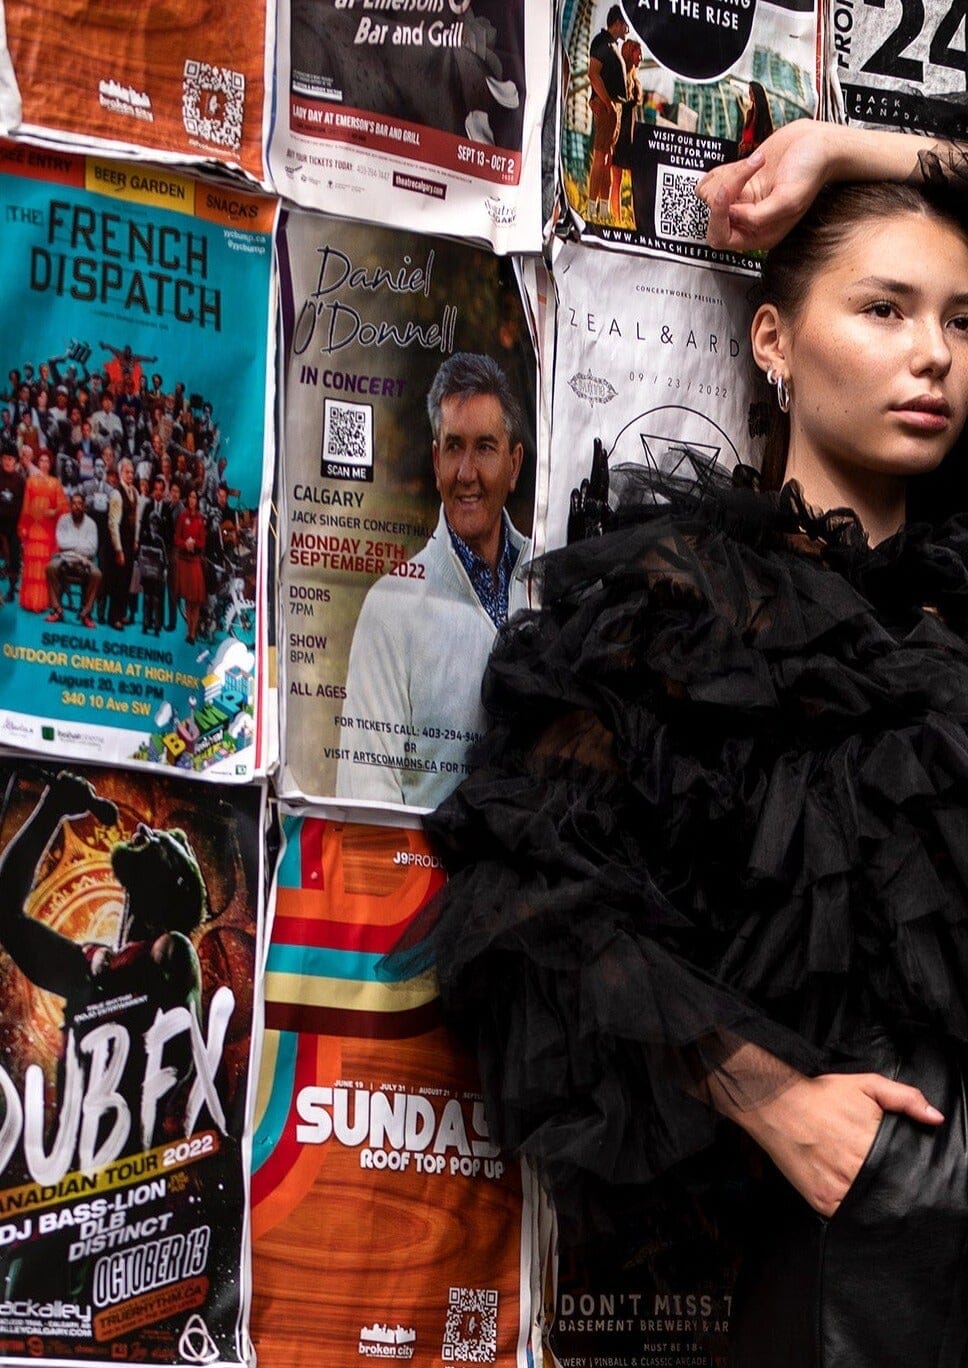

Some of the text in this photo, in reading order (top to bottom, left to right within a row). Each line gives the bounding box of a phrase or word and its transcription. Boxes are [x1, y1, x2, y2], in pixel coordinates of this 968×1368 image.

[354, 17, 464, 48] Bar and Grill
[856, 94, 901, 107] BACK
[648, 140, 725, 162] WEBSITE FOR MORE
[653, 131, 722, 151] VISIT OUR EVENT
[670, 156, 705, 168] DETAILS
[94, 166, 185, 200] BEER GARDEN
[206, 194, 259, 218] SNACKS
[48, 200, 208, 280] FRENCH
[311, 245, 436, 298] Daniel
[30, 246, 222, 333] DISPATCH
[636, 285, 692, 300] CONCERTWORKS
[293, 299, 458, 357] O'Donnell
[299, 364, 407, 398] IN CONCERT
[327, 464, 367, 480] SCAN ME
[293, 484, 365, 509] CALGARY
[290, 550, 426, 580] SEPTEMBER 2022
[289, 585, 331, 603] DOORS
[290, 602, 314, 616] 7PM
[41, 632, 174, 665] SPECIAL SCREENING
[290, 651, 315, 664] 8PM
[3, 643, 68, 666] OUTDOOR
[71, 656, 122, 678] CINEMA
[126, 664, 143, 677] AT
[145, 666, 173, 684] HIGH
[290, 682, 347, 700] ALL AGES
[334, 716, 420, 737] FOR TICKETS CALL:
[323, 748, 459, 774] VISIT ARTSCOMMONS.CA FOR
[105, 1135, 213, 1184] TOUR 2022
[360, 1148, 504, 1179] ROOF TOP POP UP
[0, 1178, 166, 1246] DJ BASS-LION
[68, 1212, 174, 1262] DISTINCT
[92, 1225, 211, 1308] OCTOBER 13
[561, 1294, 712, 1316] DON'T MISS
[559, 1320, 697, 1332] BASEMENT BREWERY
[359, 1342, 396, 1356] broken
[397, 1344, 414, 1359] city
